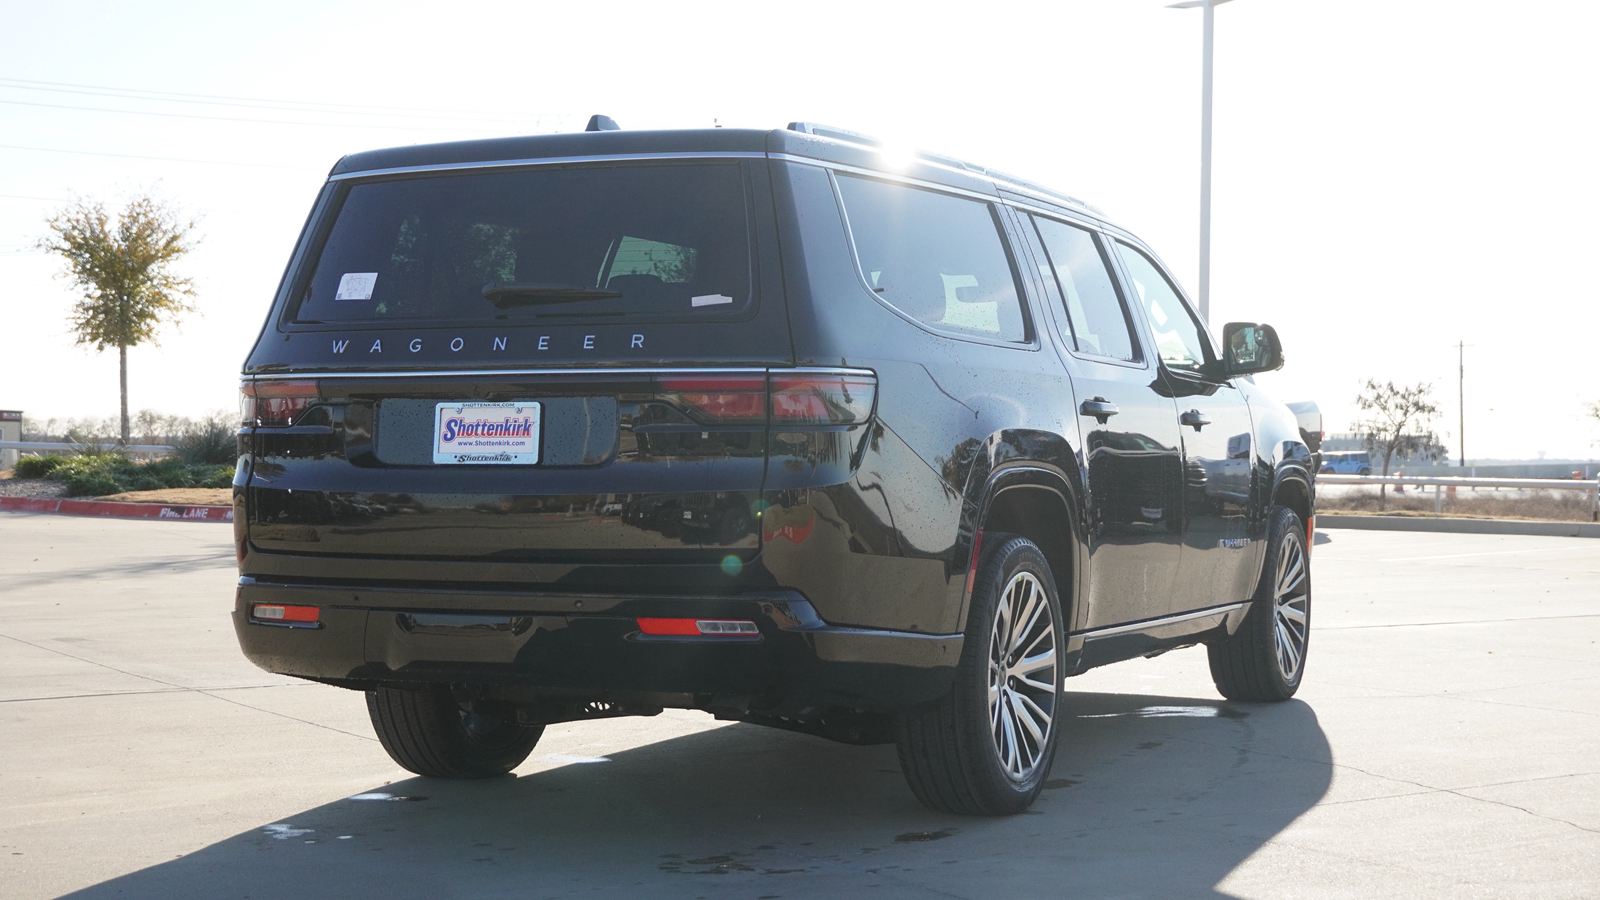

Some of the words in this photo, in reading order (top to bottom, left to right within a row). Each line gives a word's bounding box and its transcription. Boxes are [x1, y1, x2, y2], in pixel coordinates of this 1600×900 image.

[332, 334, 645, 353] WAGONEER
[443, 417, 533, 442] Shottenkirk
[182, 508, 209, 518] LANE
